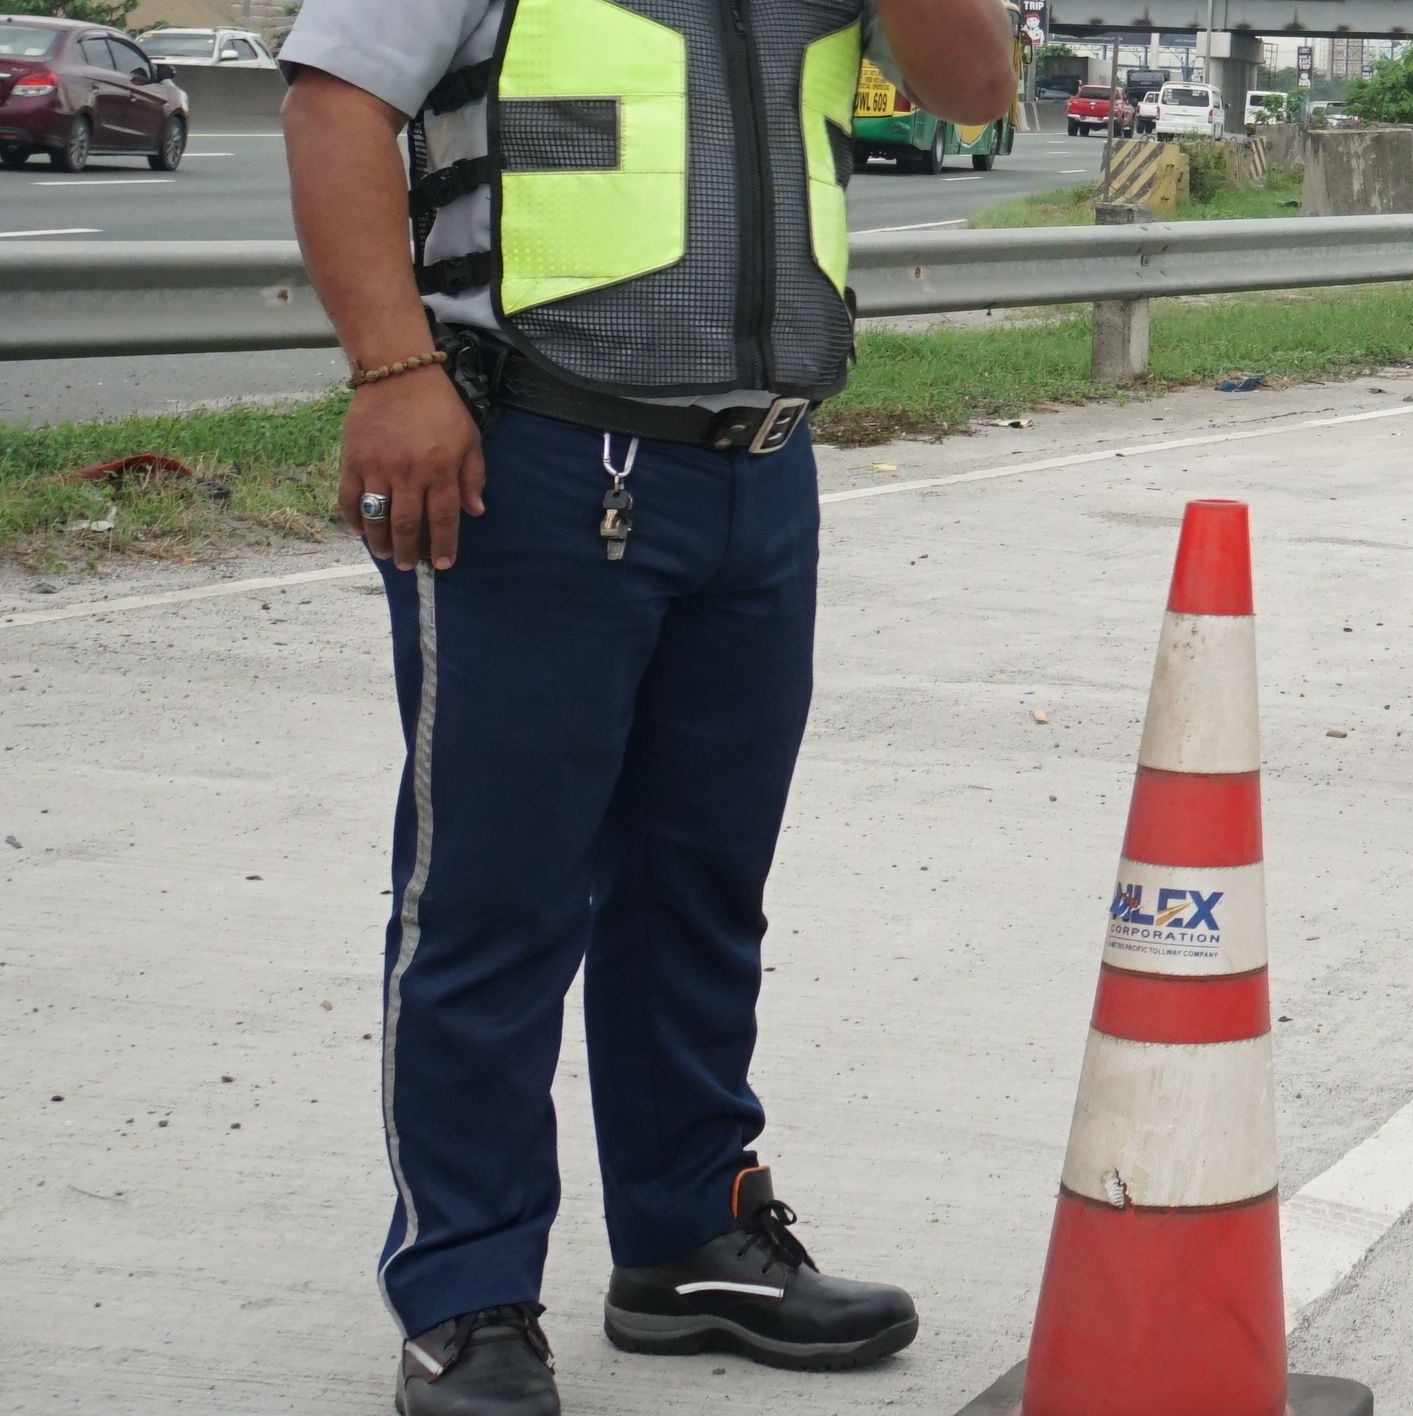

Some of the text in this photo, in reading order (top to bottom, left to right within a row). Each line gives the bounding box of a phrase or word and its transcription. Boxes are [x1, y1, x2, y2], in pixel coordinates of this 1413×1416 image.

[1023, 1, 1044, 11] TRIP
[872, 92, 888, 113] 609
[1110, 924, 1220, 943] CORPORATION
[1149, 946, 1182, 956] TOLLWAY
[1183, 950, 1218, 959] COMPANY
